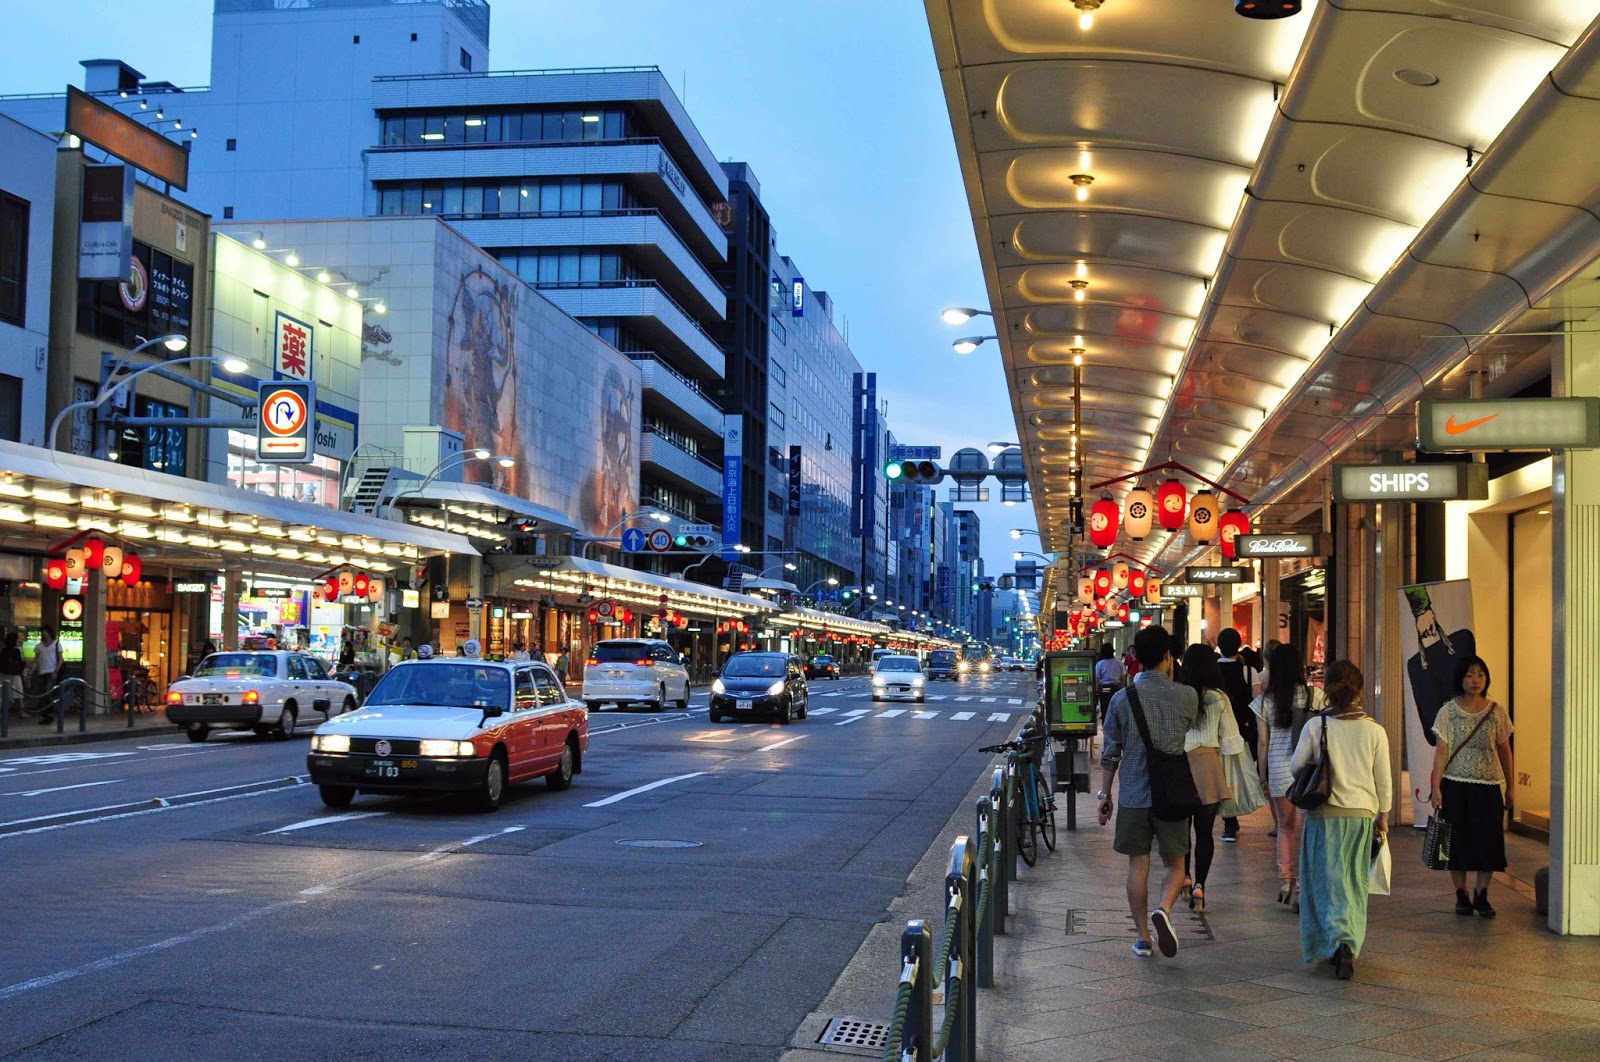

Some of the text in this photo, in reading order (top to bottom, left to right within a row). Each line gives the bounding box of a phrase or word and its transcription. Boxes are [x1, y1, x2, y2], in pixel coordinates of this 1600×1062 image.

[281, 323, 306, 377] 薬
[1369, 472, 1429, 493] SHIPS
[727, 460, 737, 532] 東京海上日動火災
[654, 535, 667, 546] 40
[1193, 571, 1237, 579] ノムラテーラー
